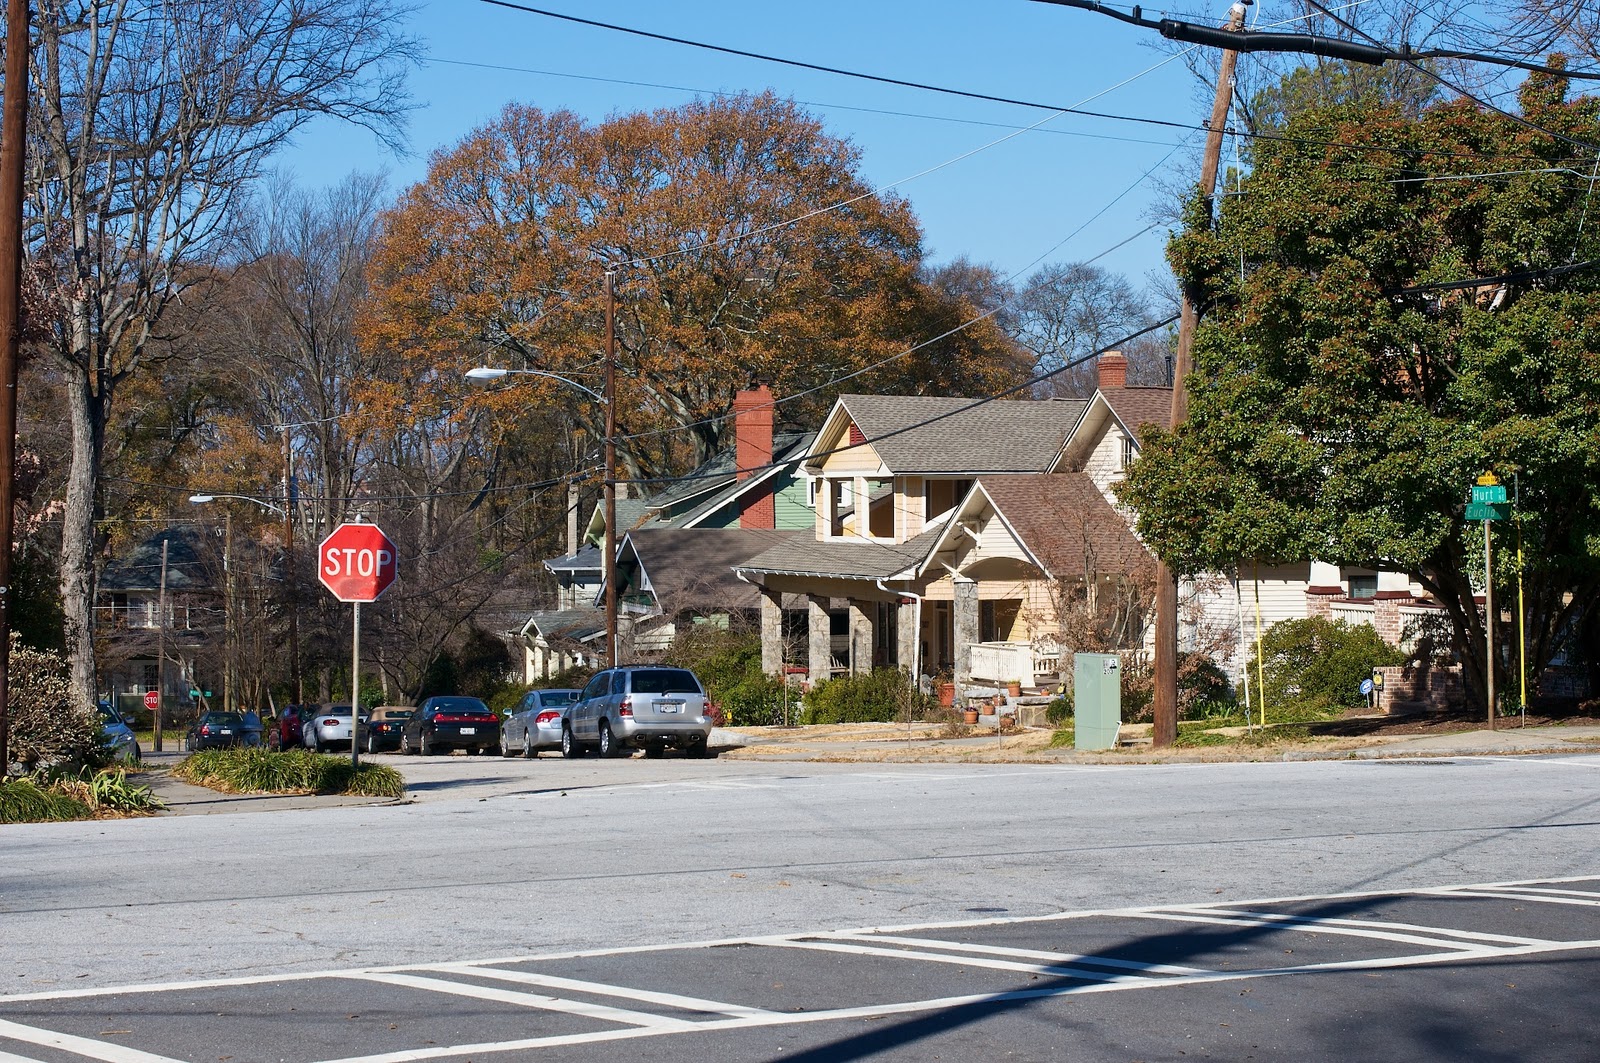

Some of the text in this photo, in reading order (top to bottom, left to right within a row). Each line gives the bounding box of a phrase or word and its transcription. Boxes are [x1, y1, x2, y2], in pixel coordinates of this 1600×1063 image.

[1473, 489, 1493, 501] Hurt
[325, 548, 392, 577] STOP
[145, 696, 158, 704] STO
